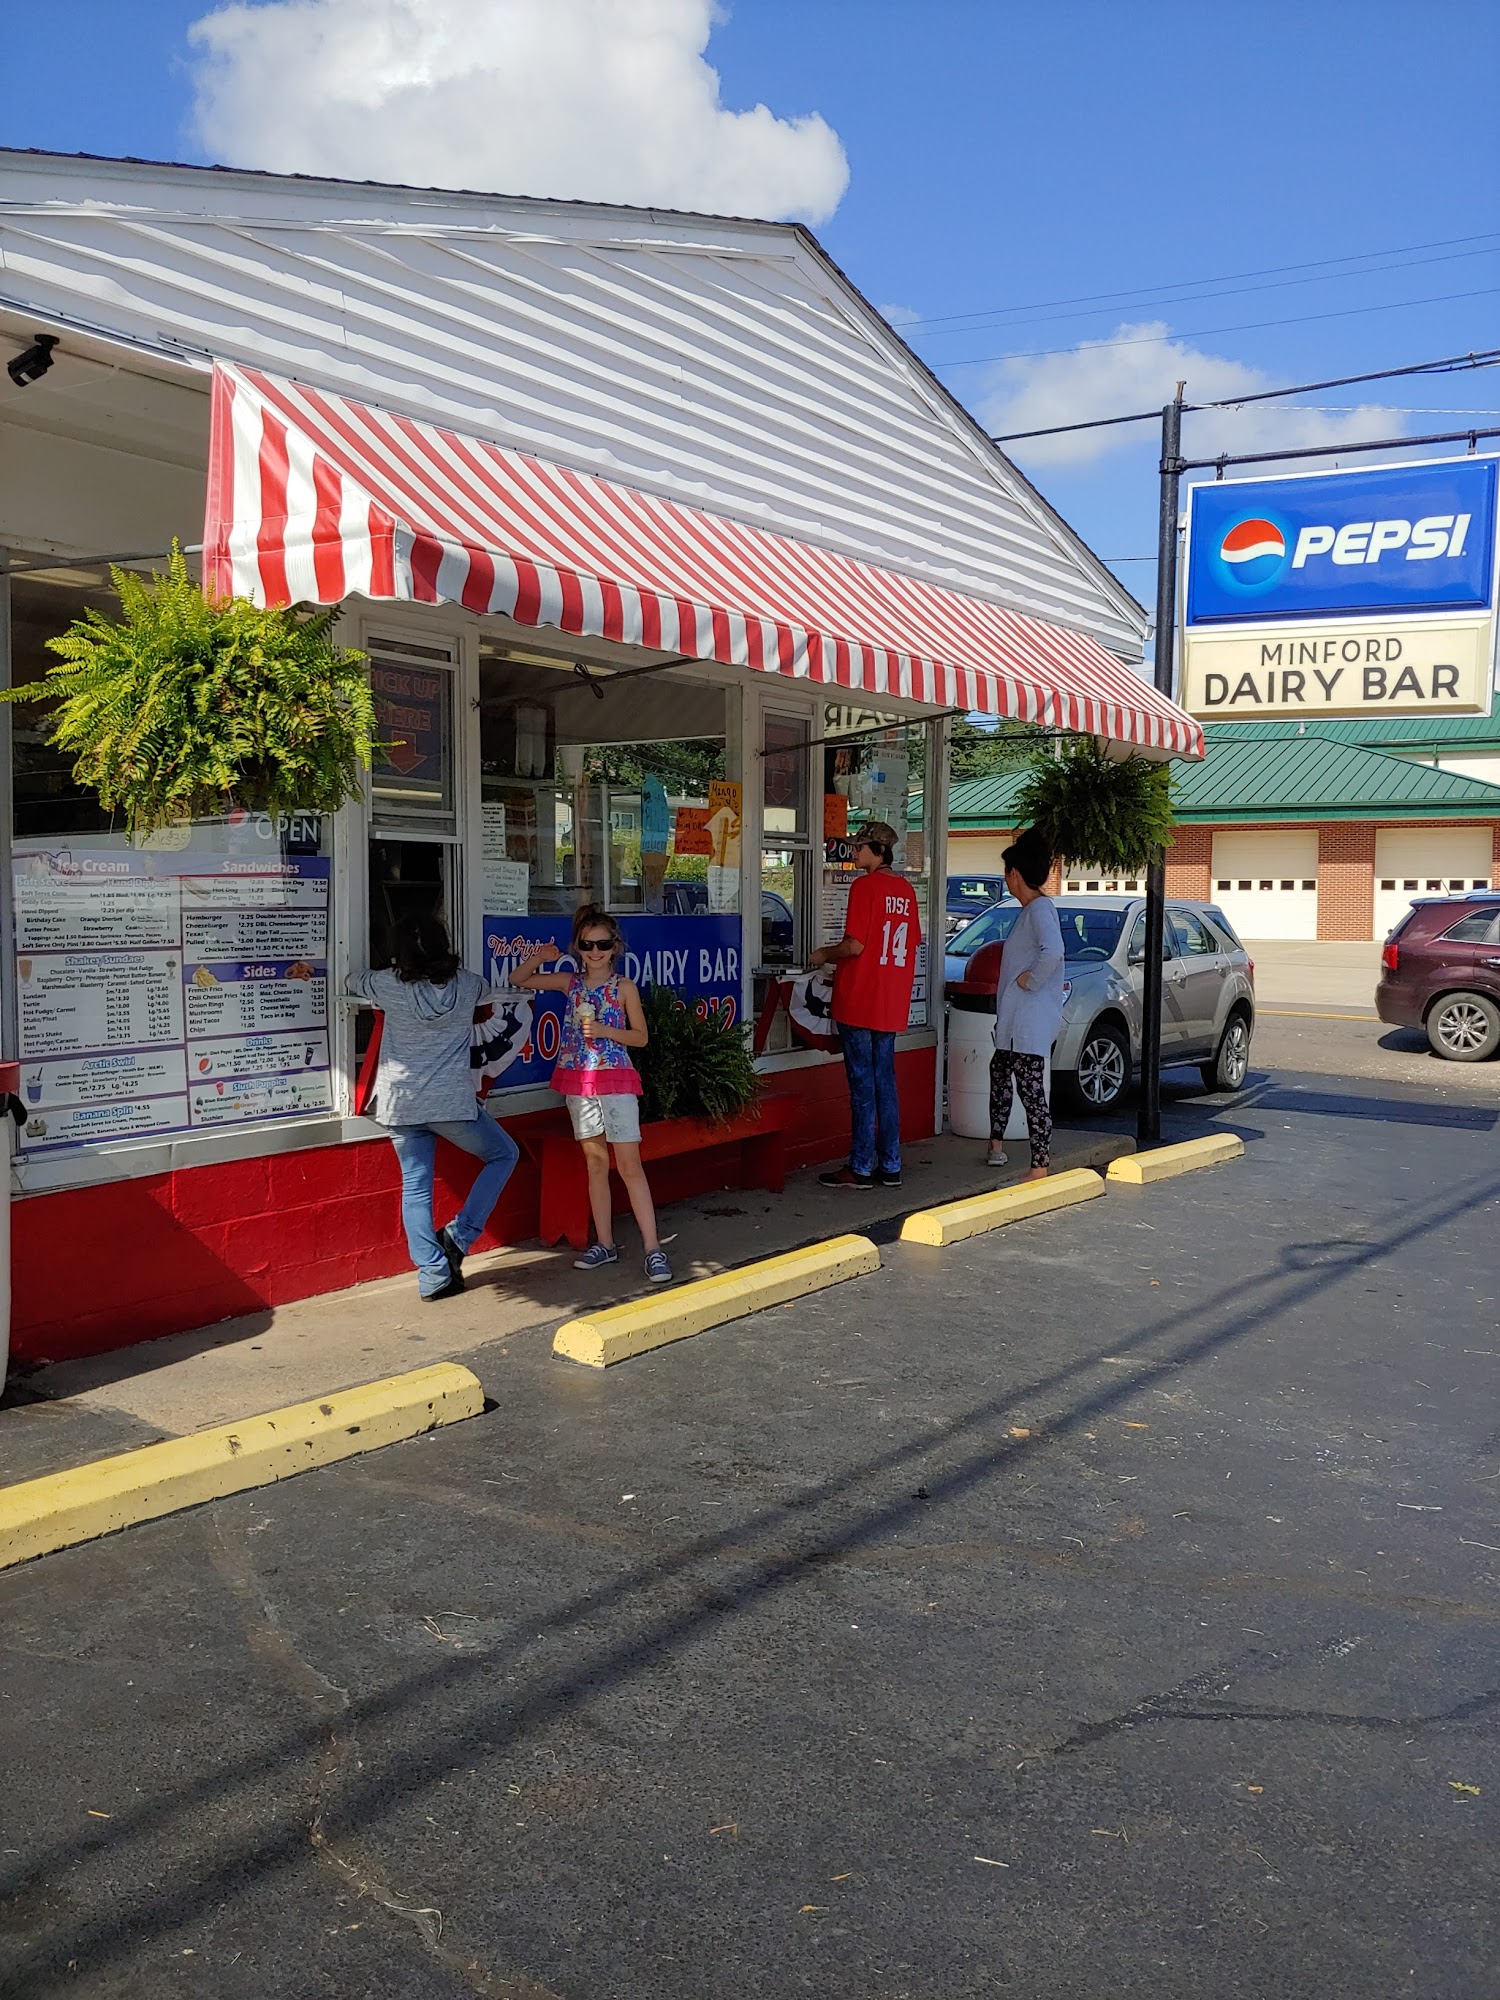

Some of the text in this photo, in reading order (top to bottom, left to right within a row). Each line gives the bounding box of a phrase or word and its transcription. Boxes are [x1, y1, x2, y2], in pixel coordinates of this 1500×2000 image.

[1291, 513, 1472, 569] PEPSI
[1261, 637, 1403, 666] MINFORD
[413, 677, 440, 699] UP
[1205, 664, 1460, 706] DAIRY BAR
[255, 816, 319, 843] OPEN
[58, 859, 130, 872] Ice Cream
[222, 861, 300, 874] Sandwiches
[17, 877, 38, 887] Soft
[106, 878, 170, 889] Hand Dipped
[487, 934, 511, 960] The
[880, 921, 908, 967] 14
[244, 965, 277, 978] Sides
[625, 950, 689, 988] DAIRY
[700, 948, 738, 983] BAR
[246, 1037, 272, 1047] Drinks
[82, 1056, 135, 1070] Arctic Swirl
[233, 1078, 287, 1092] Slush Puppies
[73, 1109, 110, 1121] Banana
[112, 1106, 133, 1118] Split
